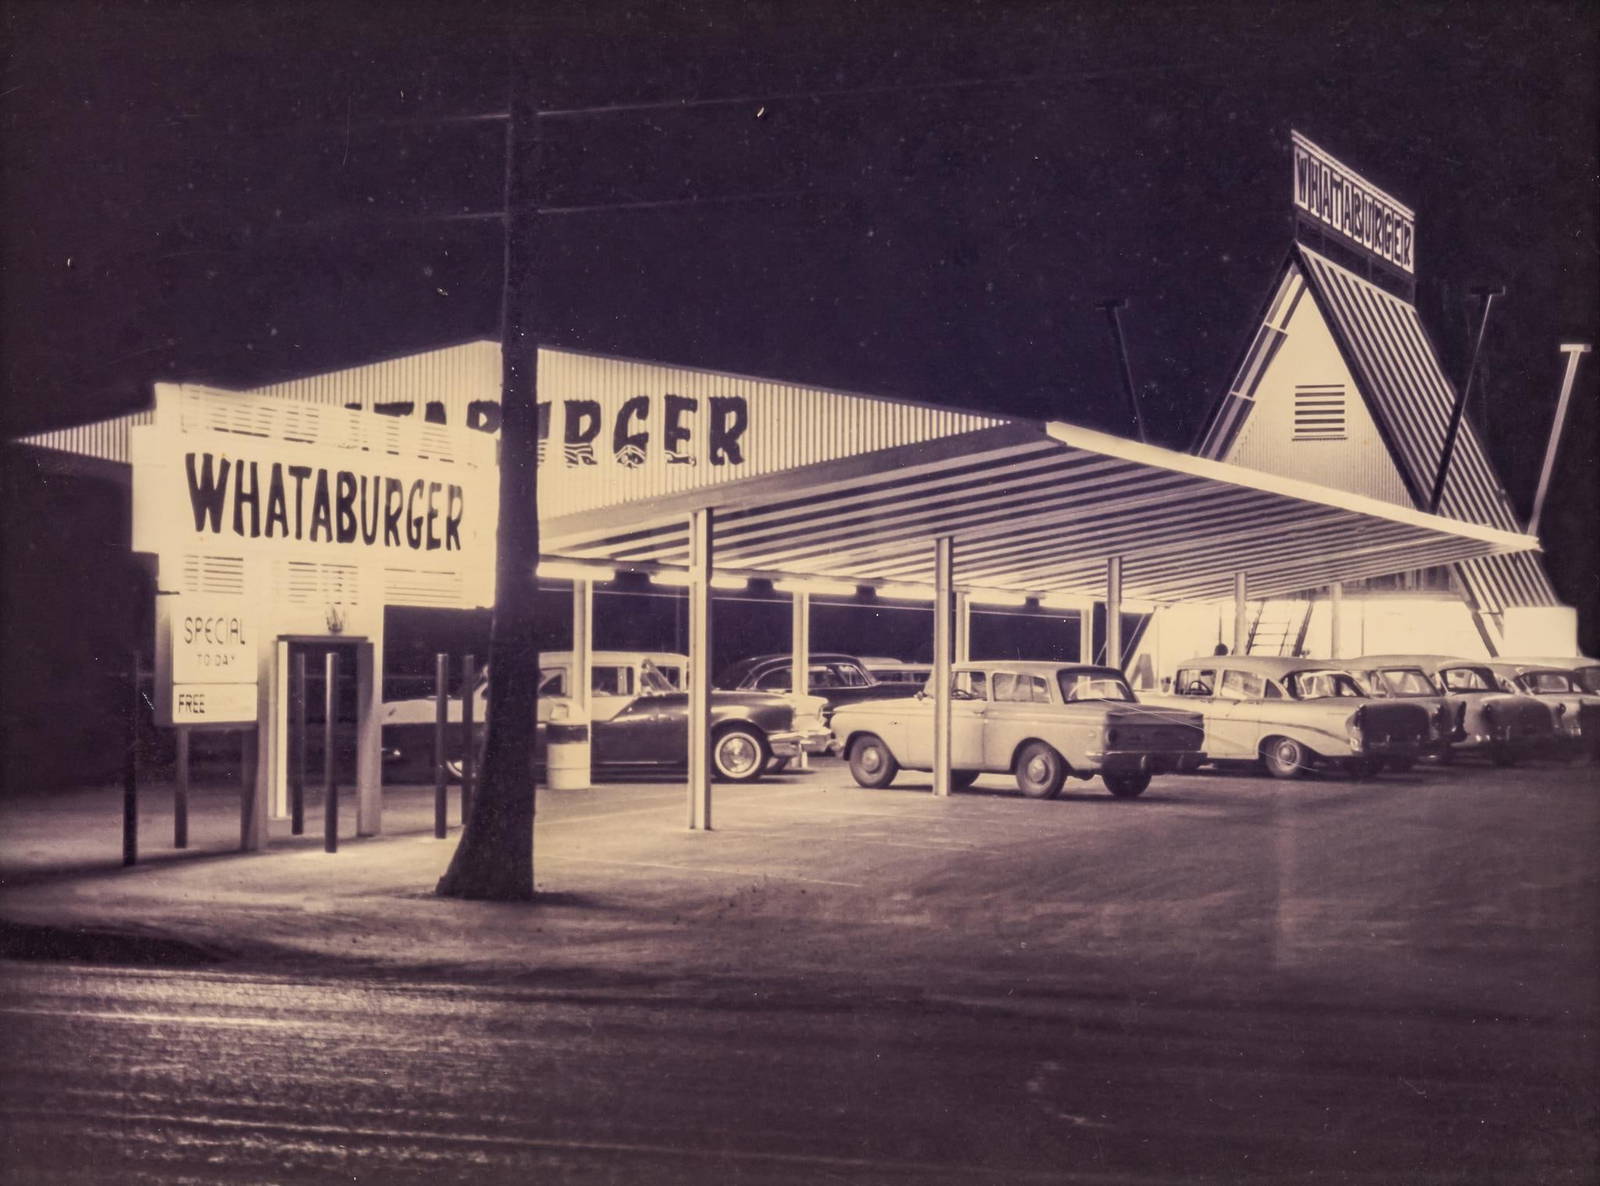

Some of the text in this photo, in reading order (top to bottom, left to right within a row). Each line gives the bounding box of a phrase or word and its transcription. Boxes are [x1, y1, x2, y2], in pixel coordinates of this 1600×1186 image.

[1296, 151, 1411, 267] WHATABURGER
[185, 452, 464, 551] WHATABURGER
[184, 616, 246, 645] SPECIAL
[178, 693, 206, 714] FREE
